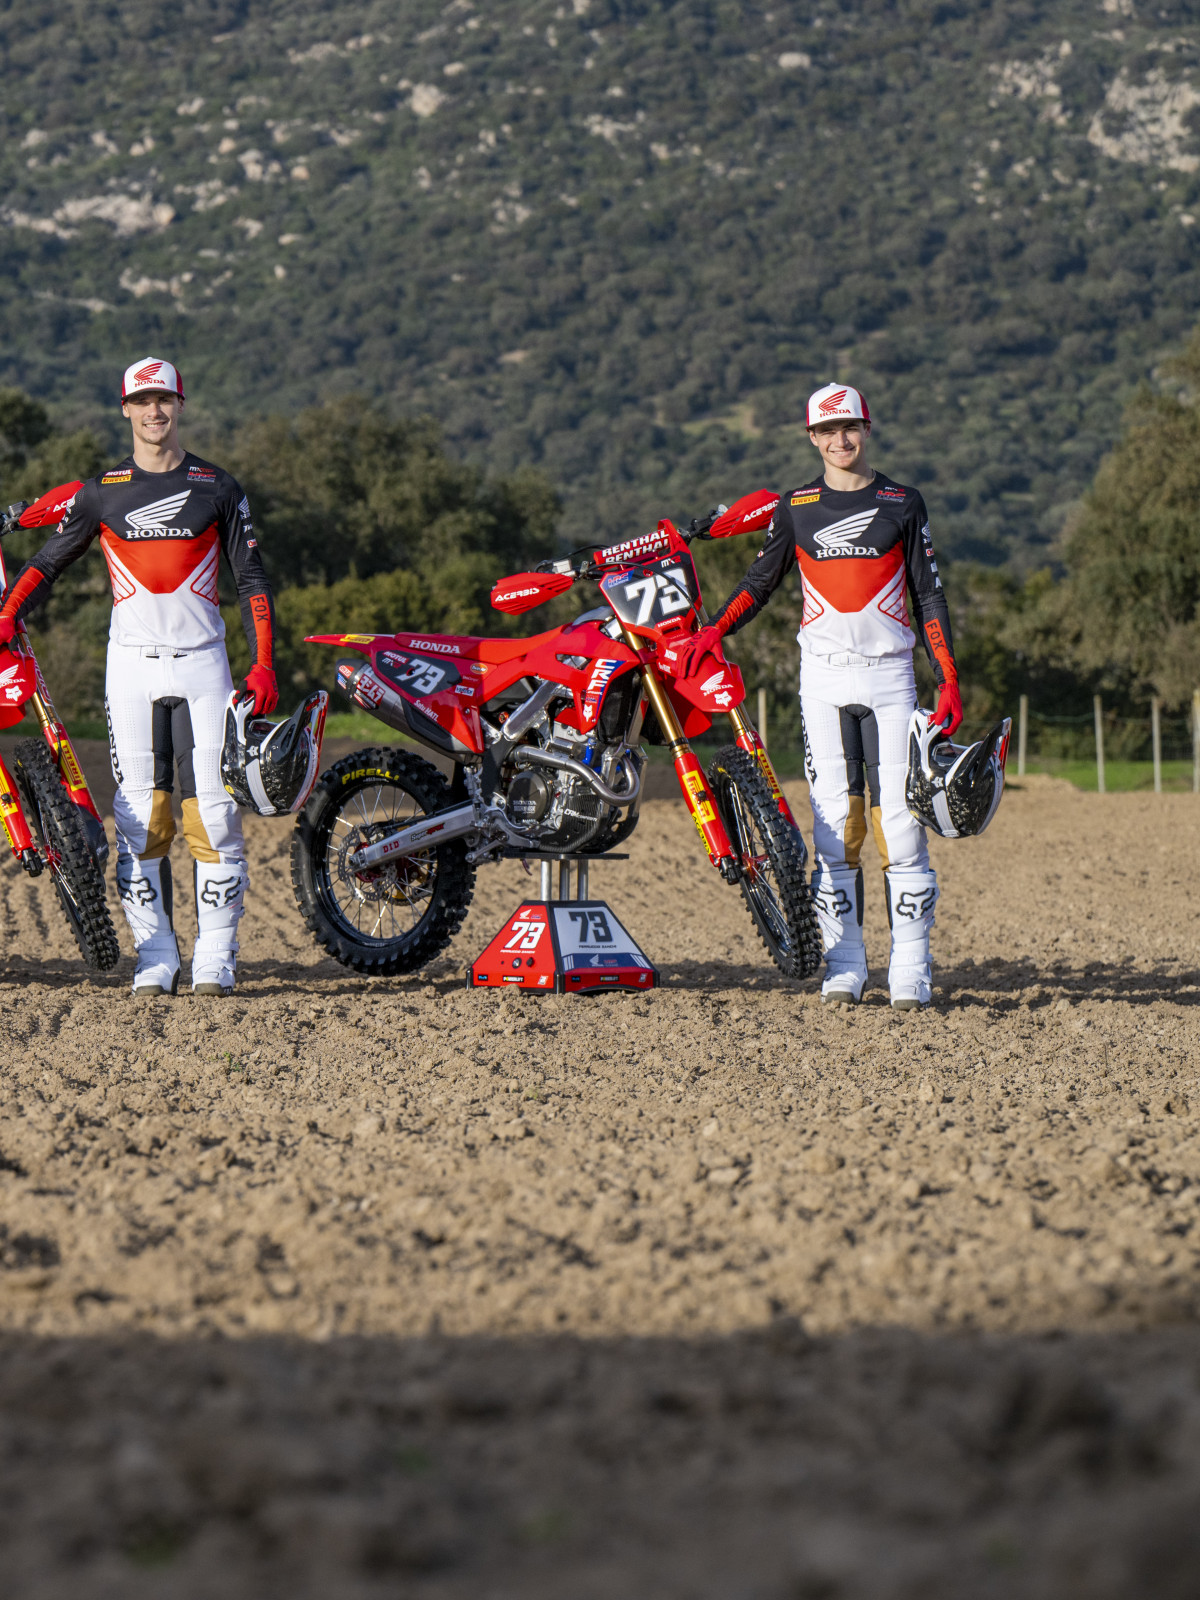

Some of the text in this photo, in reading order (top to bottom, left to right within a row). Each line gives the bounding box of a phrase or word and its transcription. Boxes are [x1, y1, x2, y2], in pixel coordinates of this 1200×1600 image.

[134, 379, 166, 387] HONDA
[819, 409, 851, 418] HONDA
[125, 528, 194, 539] HONDA
[601, 528, 669, 557] RENTHAL
[605, 538, 669, 563] RENTHAL
[816, 547, 880, 559] HONDA
[661, 555, 681, 568] MX2
[495, 588, 540, 602] ACERBIS
[624, 568, 690, 626] 73
[252, 596, 269, 622] FOX
[657, 617, 682, 628] HONDA
[926, 622, 945, 650] FOX
[409, 640, 460, 654] HONDA
[383, 651, 408, 664] MOTUL
[396, 658, 445, 695] 73
[587, 658, 617, 691] CRF
[703, 683, 734, 696] HONDA
[63, 744, 82, 786] PIRELLI
[342, 768, 400, 785] PIRELLI
[383, 840, 400, 853] DID
[568, 911, 613, 943] 73
[504, 921, 546, 949] 73
